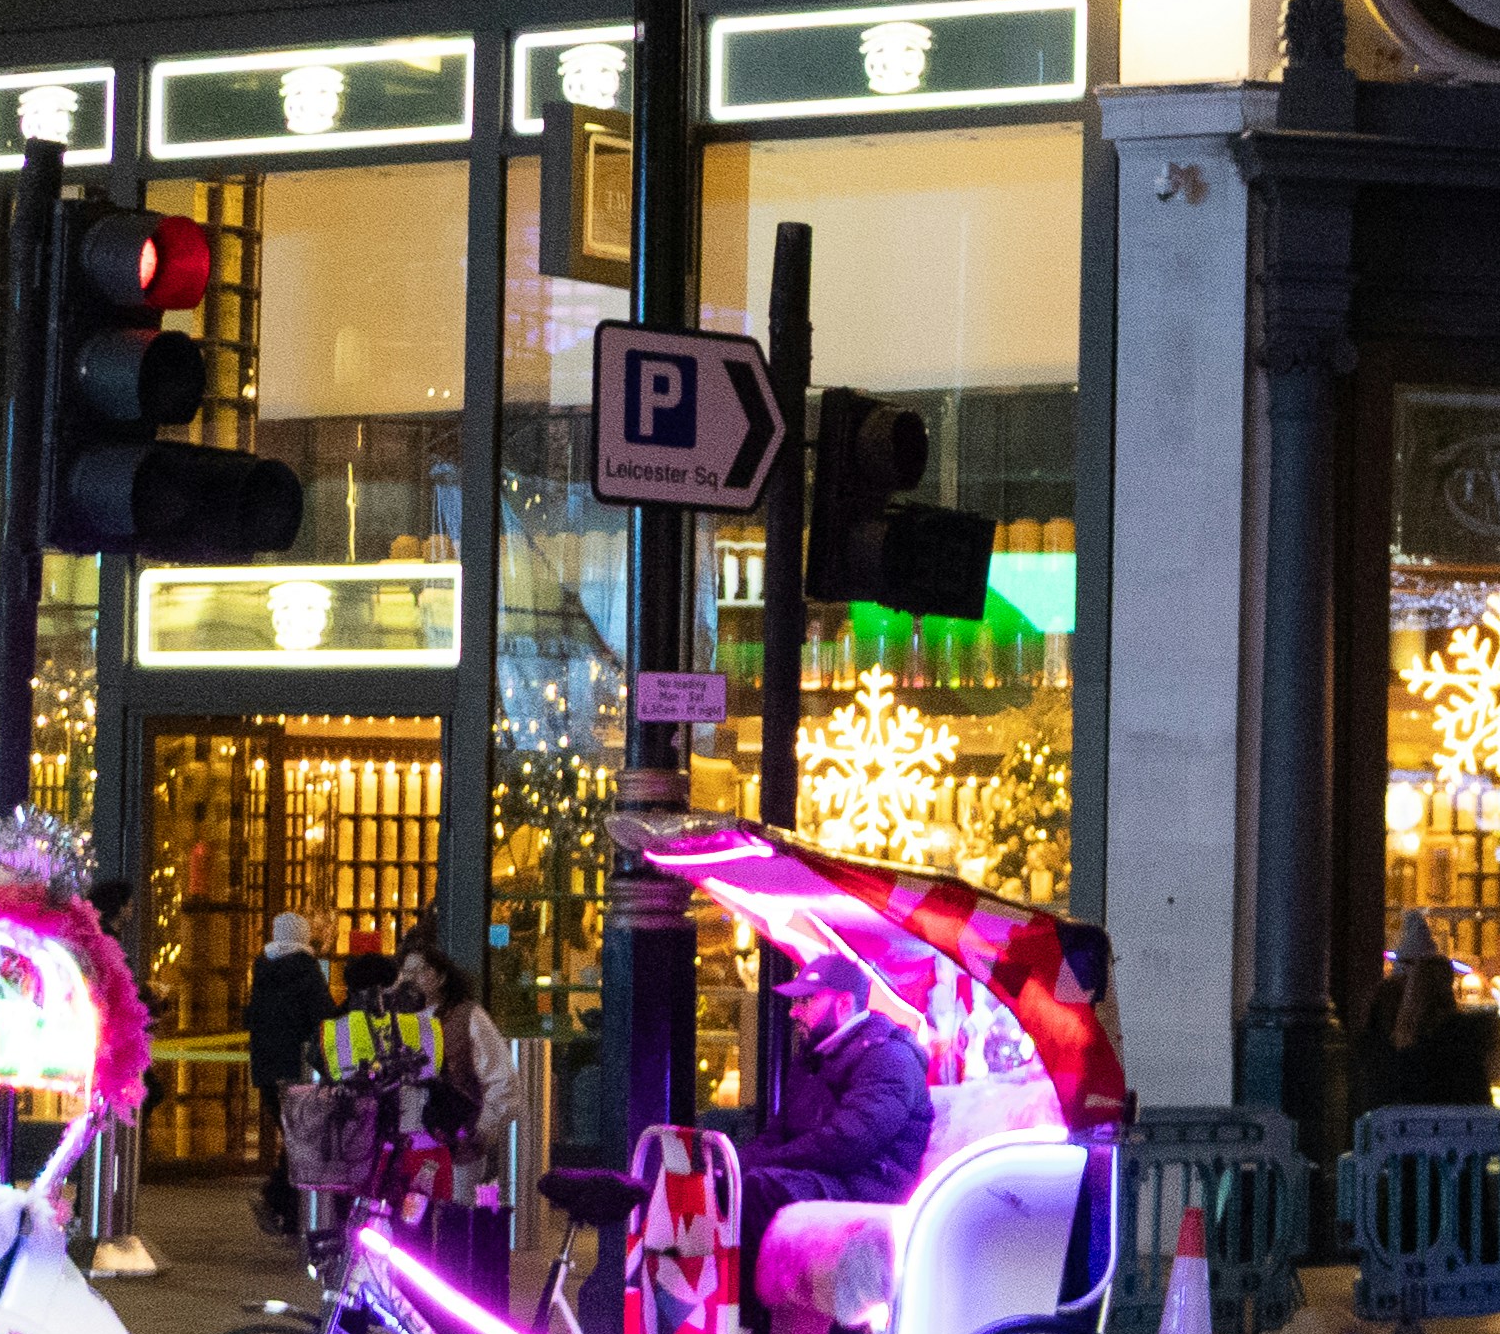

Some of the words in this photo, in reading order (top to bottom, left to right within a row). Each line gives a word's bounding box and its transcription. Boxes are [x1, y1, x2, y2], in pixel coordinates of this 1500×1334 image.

[638, 360, 683, 436] P
[604, 457, 689, 484] Leicester
[694, 466, 719, 492] Sq
